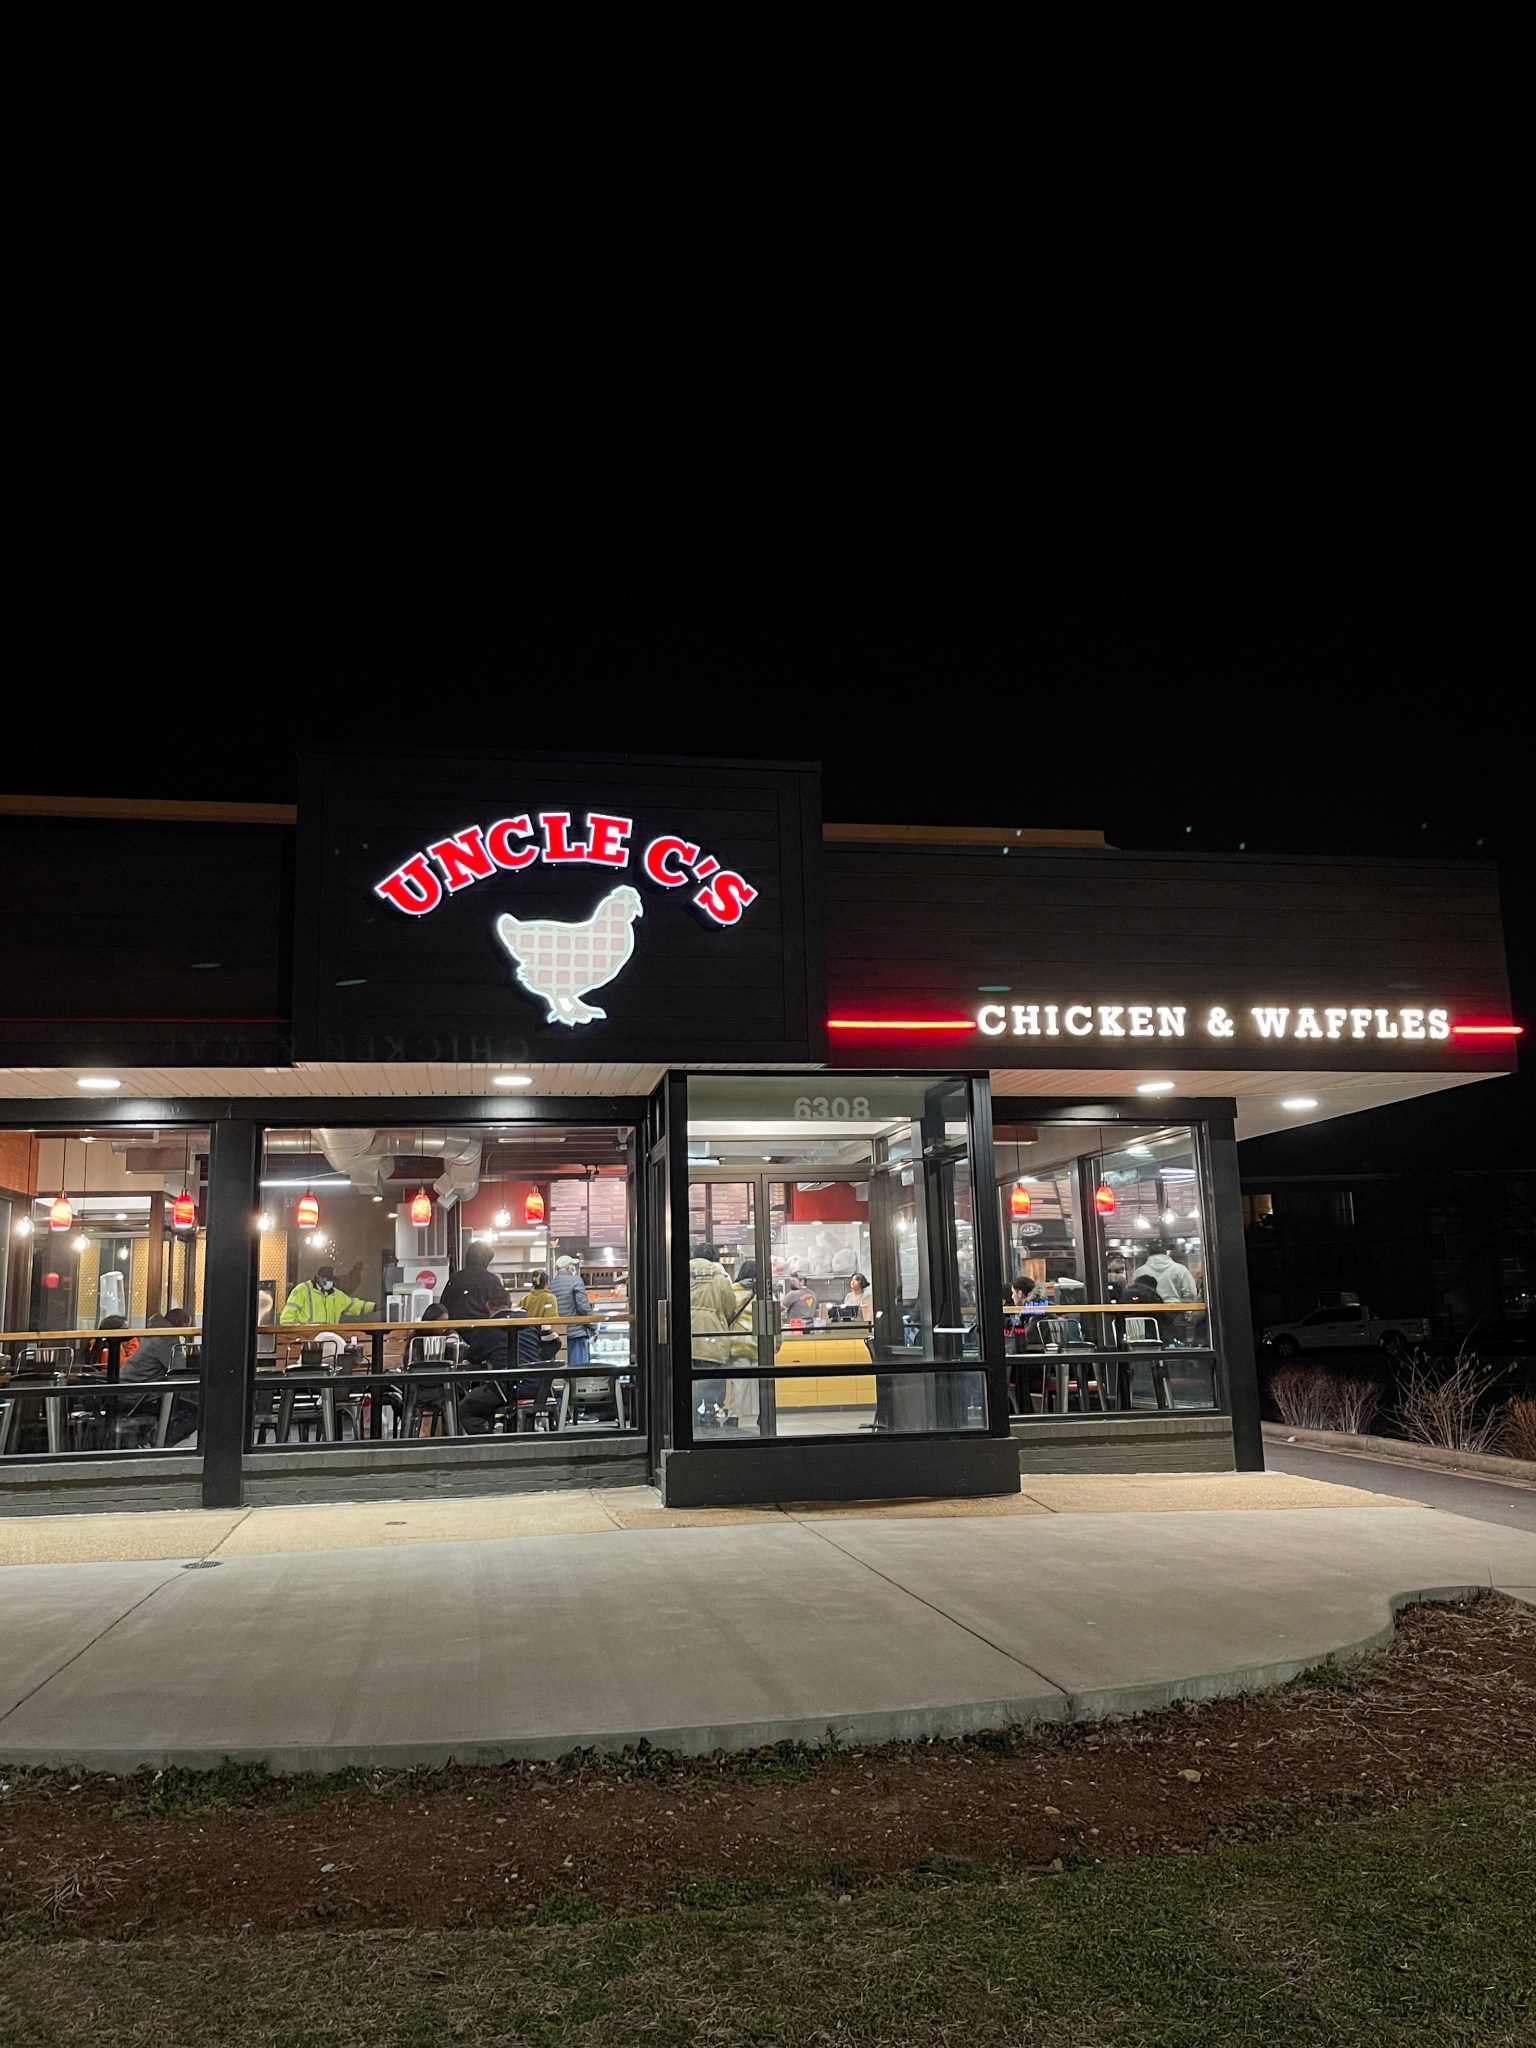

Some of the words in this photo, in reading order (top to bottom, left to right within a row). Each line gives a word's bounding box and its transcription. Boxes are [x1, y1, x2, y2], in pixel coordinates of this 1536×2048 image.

[374, 812, 633, 918] UNCLE
[644, 836, 758, 925] C'S
[977, 1005, 1187, 1036] CHICKEN
[1206, 1006, 1235, 1037] &
[1251, 1007, 1450, 1039] WAFFLES
[794, 1096, 871, 1121] 6308
